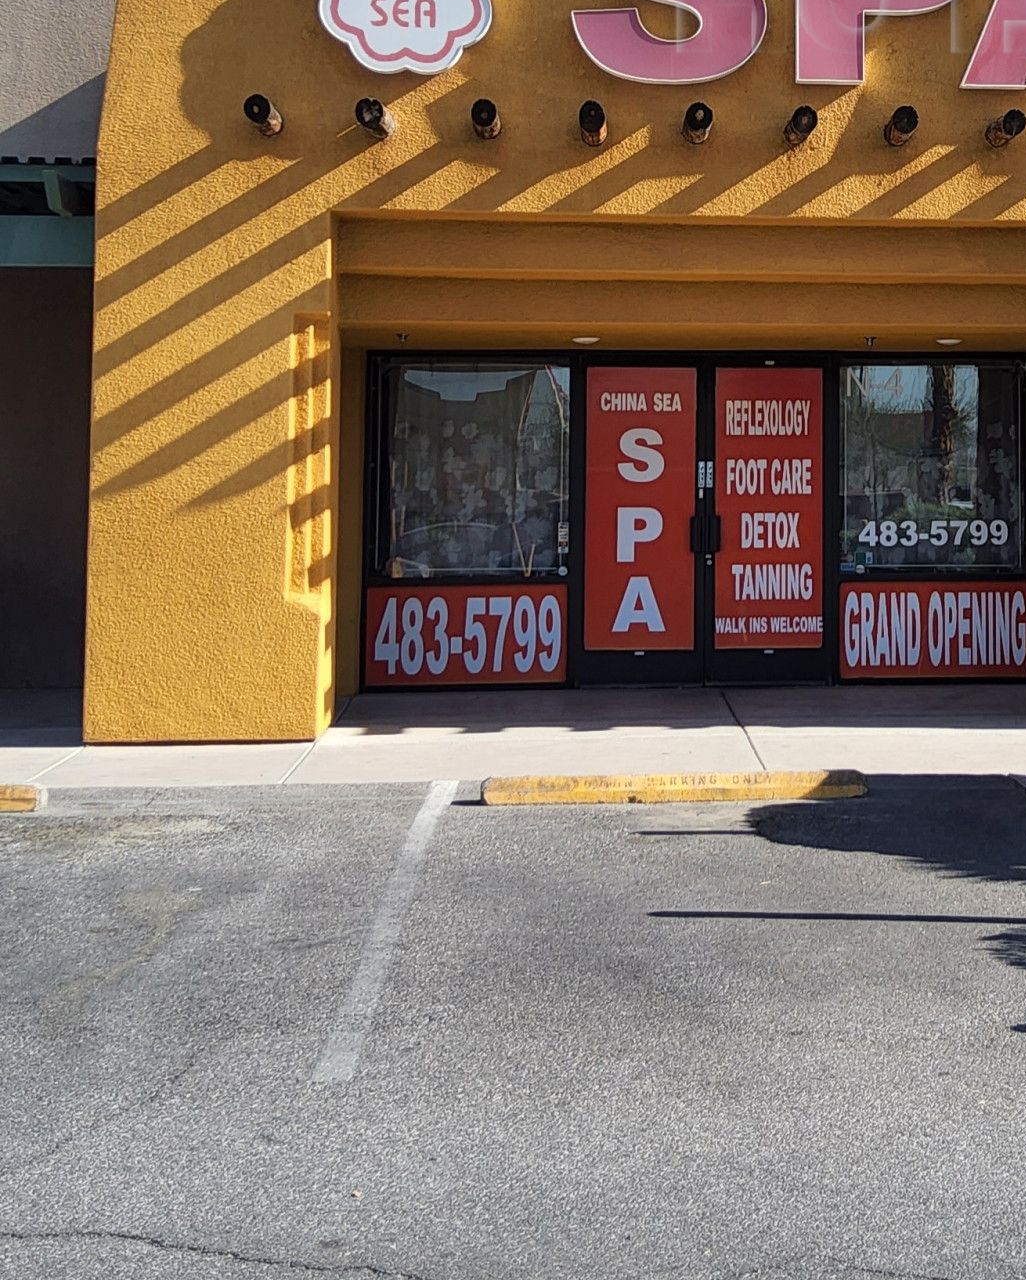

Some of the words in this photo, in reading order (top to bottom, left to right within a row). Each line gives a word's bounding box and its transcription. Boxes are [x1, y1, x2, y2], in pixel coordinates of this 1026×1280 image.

[600, 392, 647, 412] CHINA
[653, 392, 682, 412] SEA
[725, 399, 811, 436] REFLEXOLOGY
[726, 458, 768, 496] FOOT
[771, 458, 812, 495] CARE
[741, 512, 800, 549] DETOX
[858, 519, 1009, 547] 483-5799
[731, 563, 813, 600] TANNING
[374, 595, 562, 675] 483-5799
[714, 616, 746, 634] WALK
[749, 616, 767, 634] INS
[770, 615, 824, 633] WELCOME
[844, 590, 921, 667] GRAND
[928, 590, 1026, 666] OPENING
